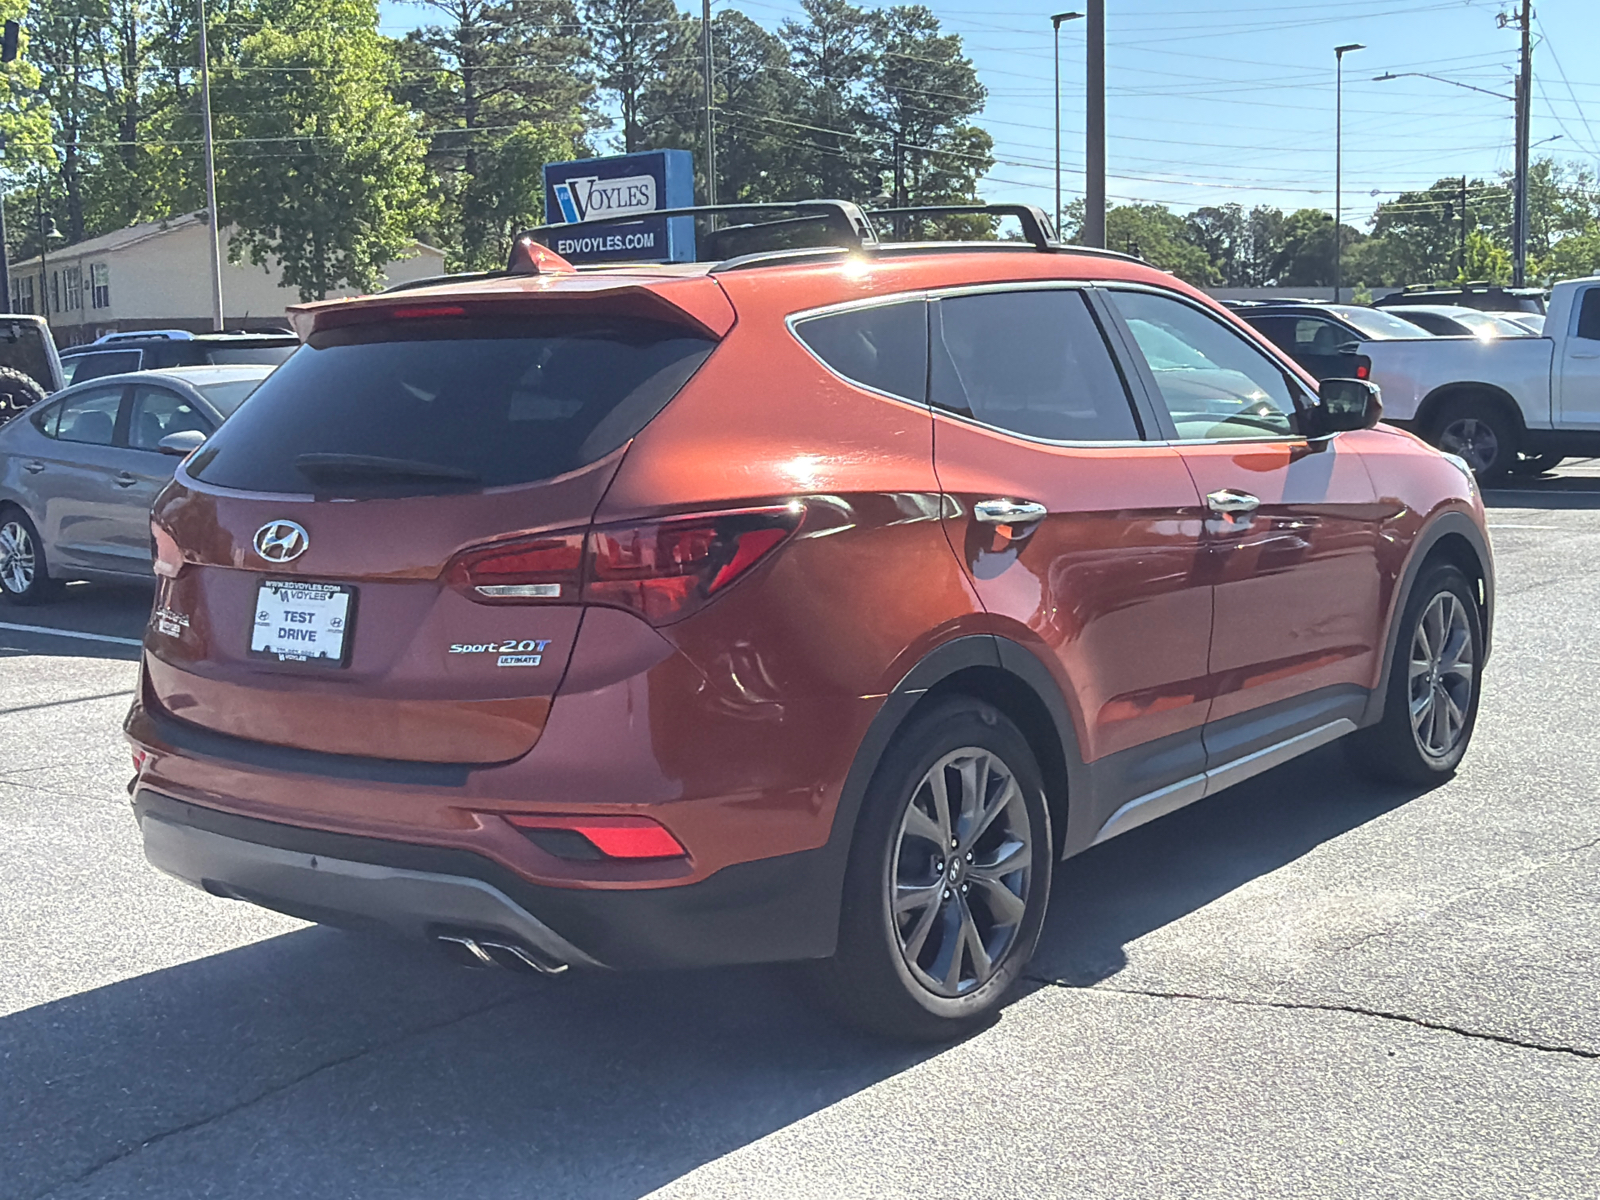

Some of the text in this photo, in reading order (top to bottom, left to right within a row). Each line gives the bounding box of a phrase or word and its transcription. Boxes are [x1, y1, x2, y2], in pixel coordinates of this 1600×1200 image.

[567, 180, 649, 221] VOYLES
[558, 233, 654, 254] EDVOYLES.COM
[265, 580, 341, 592] WWW.EDVOYLES.COM
[290, 590, 327, 601] VOYLES
[284, 610, 315, 624] TEST
[278, 627, 317, 642] DRIVE
[500, 656, 538, 664] ULTIMATE
